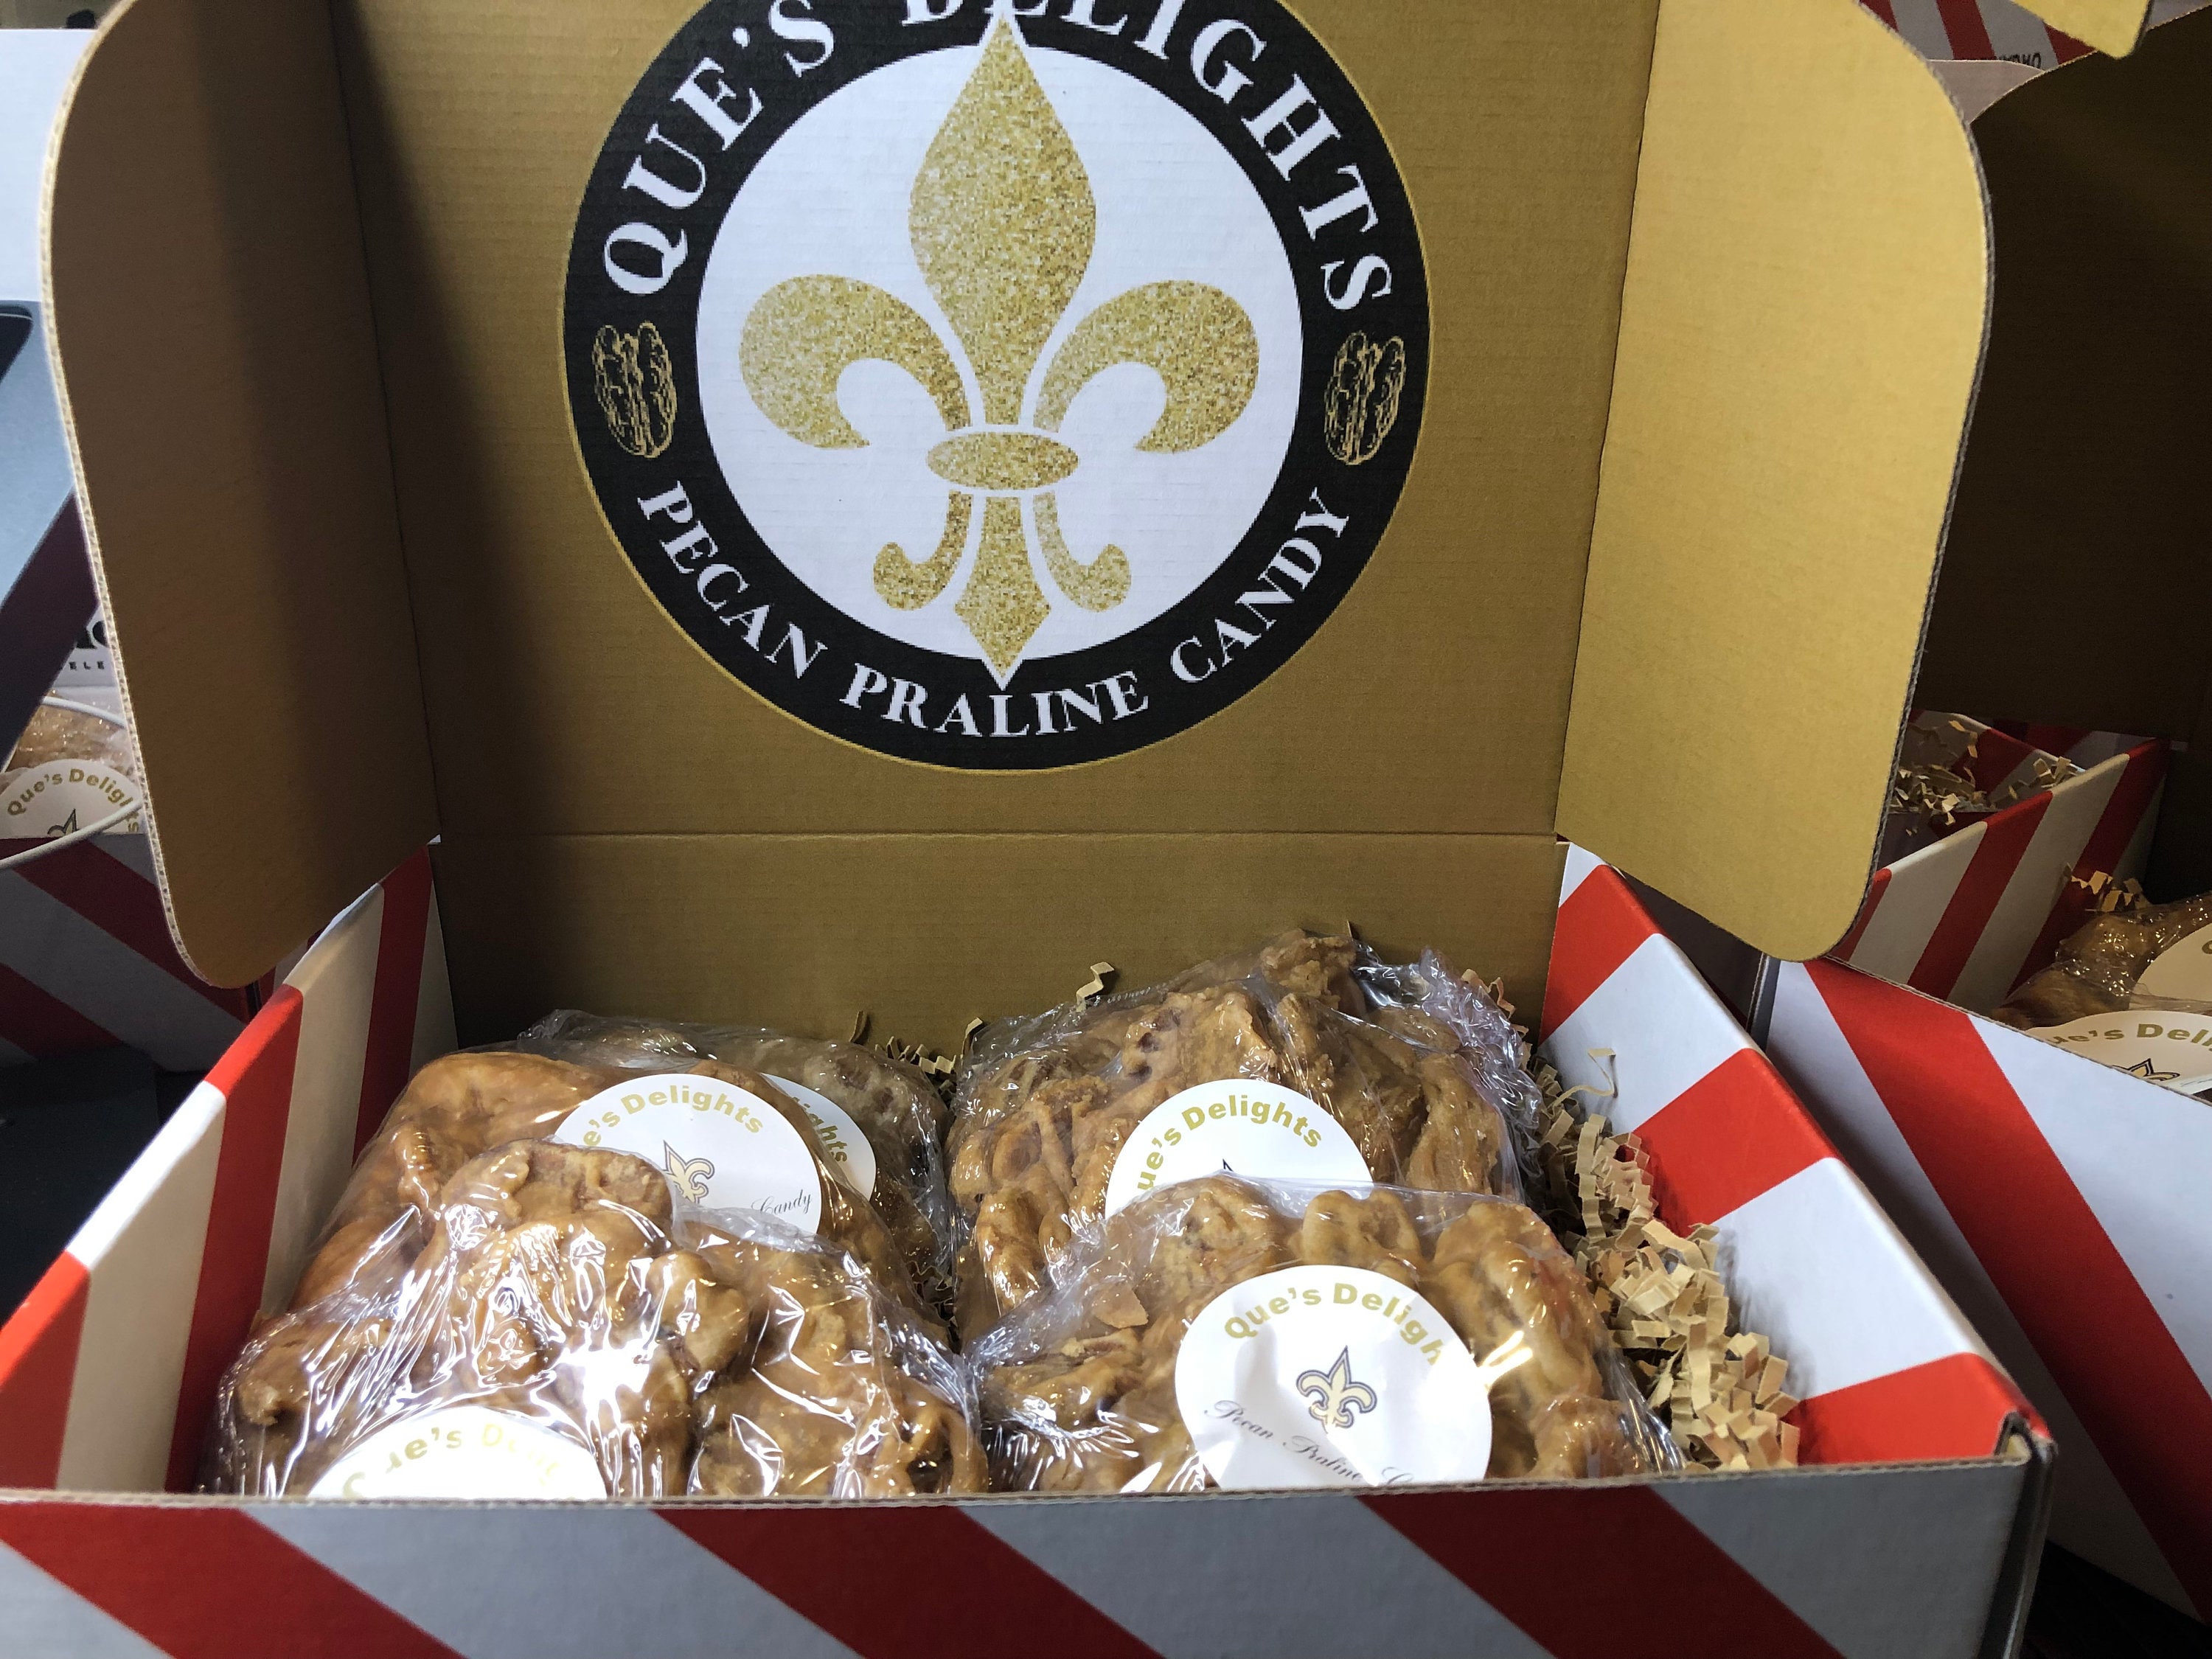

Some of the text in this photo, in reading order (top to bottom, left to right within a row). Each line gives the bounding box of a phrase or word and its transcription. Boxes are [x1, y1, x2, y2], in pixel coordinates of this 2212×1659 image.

[603, 0, 1392, 310] QUE'S LIGHTS
[636, 479, 1350, 737] PECAN PRALINE CANDY
[7, 773, 63, 815] Que's
[582, 1085, 764, 1147] e's Delights
[1138, 1094, 1322, 1190] ue's Delights
[751, 1188, 813, 1215] Candy
[1224, 1283, 1447, 1366] Que's Deligh
[1204, 1400, 1274, 1439] Pecan
